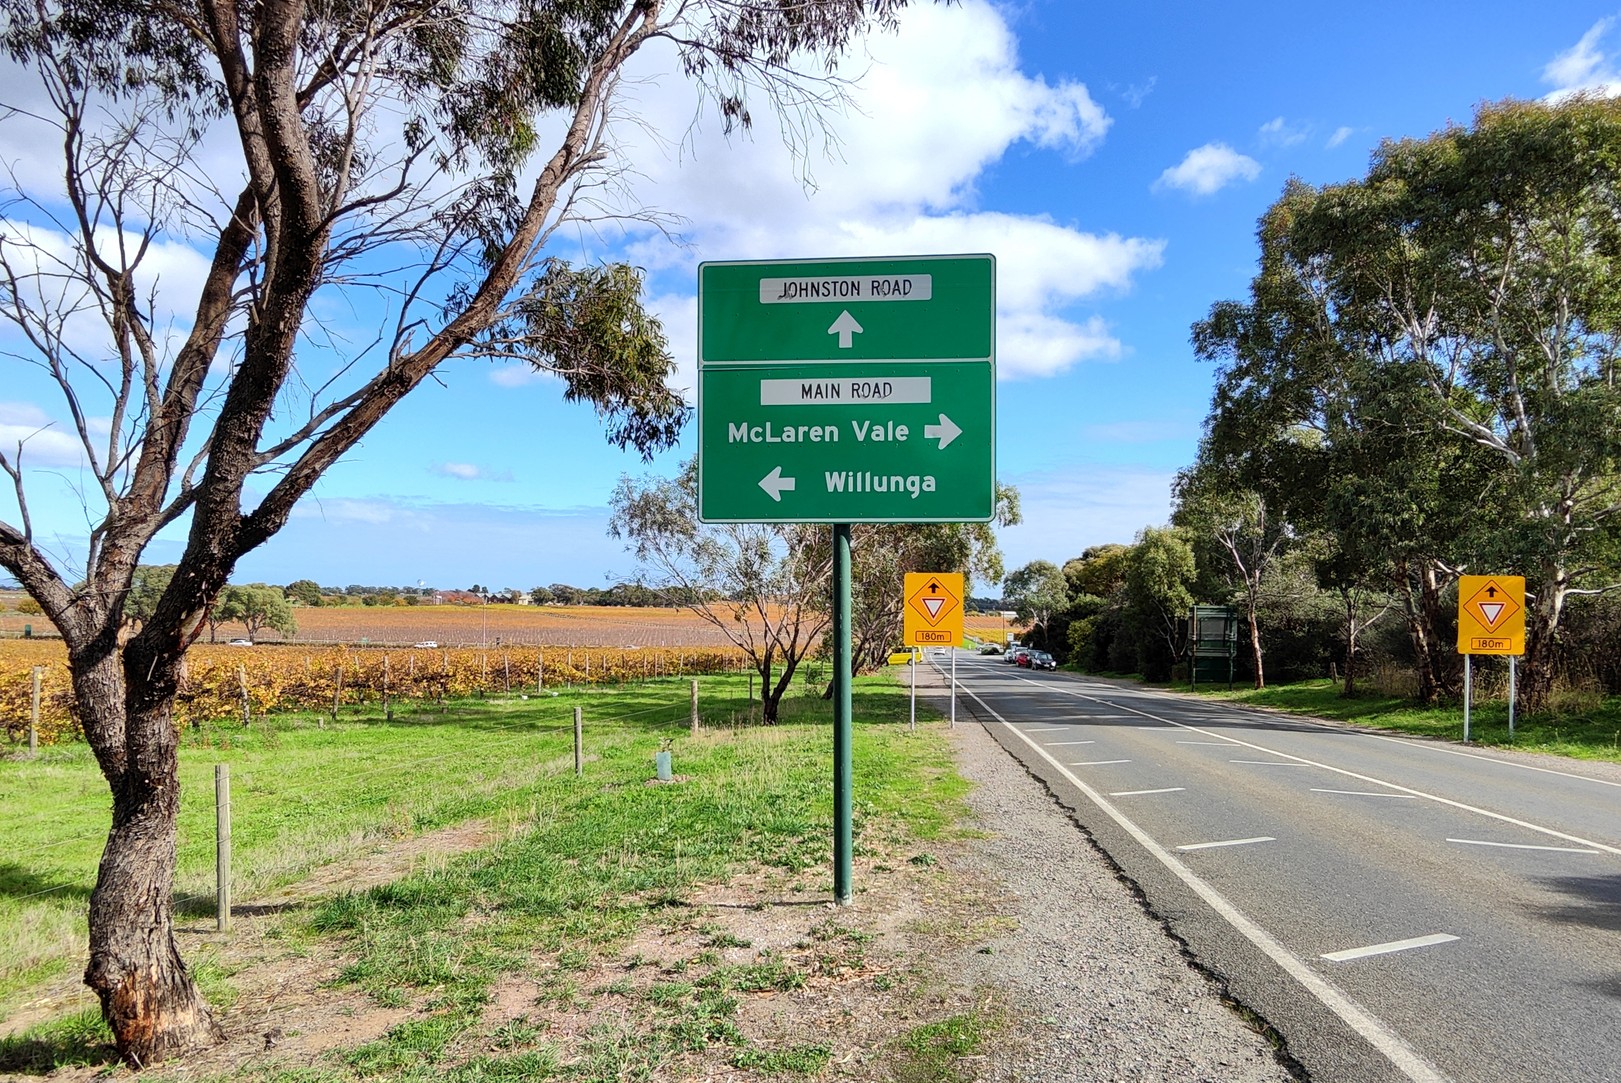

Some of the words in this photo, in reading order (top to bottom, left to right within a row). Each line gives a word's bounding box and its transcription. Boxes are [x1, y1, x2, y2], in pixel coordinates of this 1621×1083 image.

[779, 279, 861, 299] JOHNSTON
[871, 279, 913, 297] ROAD
[801, 382, 841, 400] MAIN
[851, 381, 893, 400] ROAD
[728, 421, 839, 443] McLaren
[852, 420, 910, 442] Vale
[825, 471, 936, 499] Willunga
[921, 632, 945, 641] 180m
[1478, 639, 1504, 648] 180m
